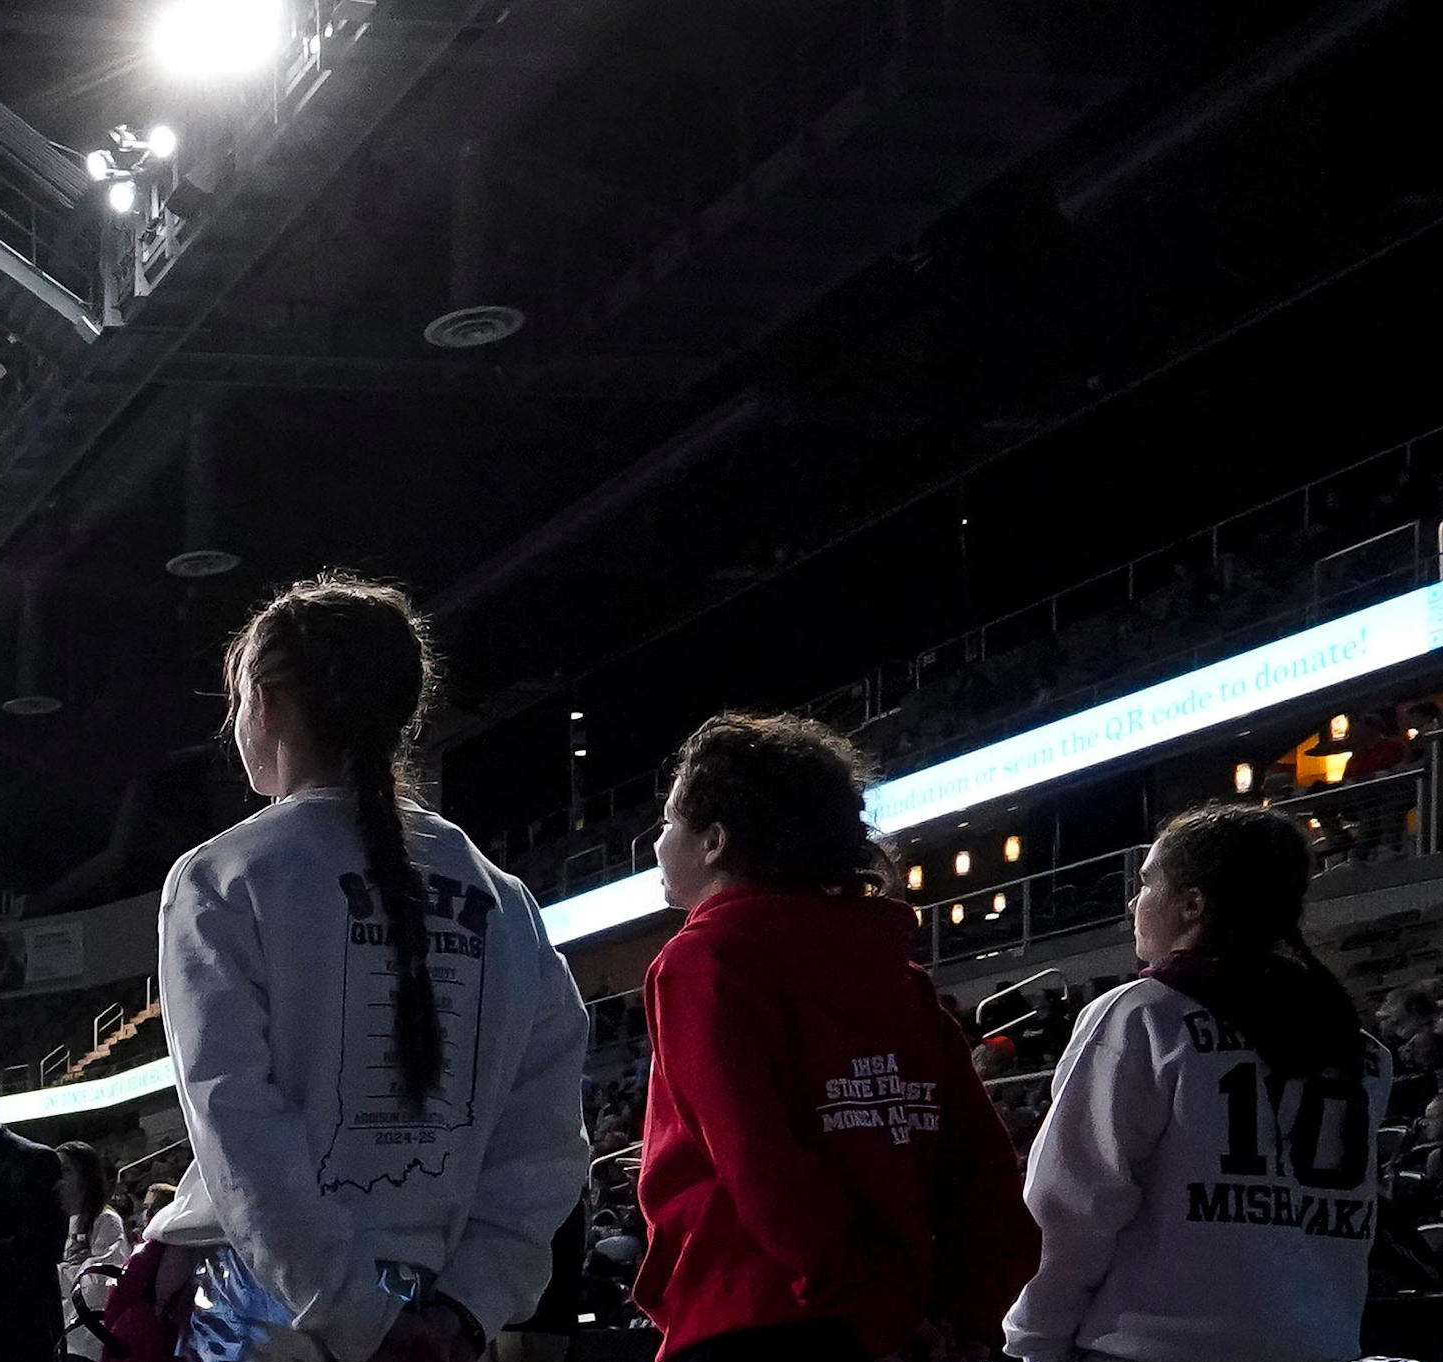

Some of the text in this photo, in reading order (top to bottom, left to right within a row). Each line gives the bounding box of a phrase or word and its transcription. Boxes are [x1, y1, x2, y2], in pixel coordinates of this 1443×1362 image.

[1002, 747, 1055, 774] scan
[1060, 730, 1099, 757] the
[1105, 707, 1145, 742] QR
[1150, 688, 1212, 727] code
[1218, 680, 1247, 704] to
[1254, 626, 1368, 691] donate!
[1219, 1063, 1369, 1190] 10
